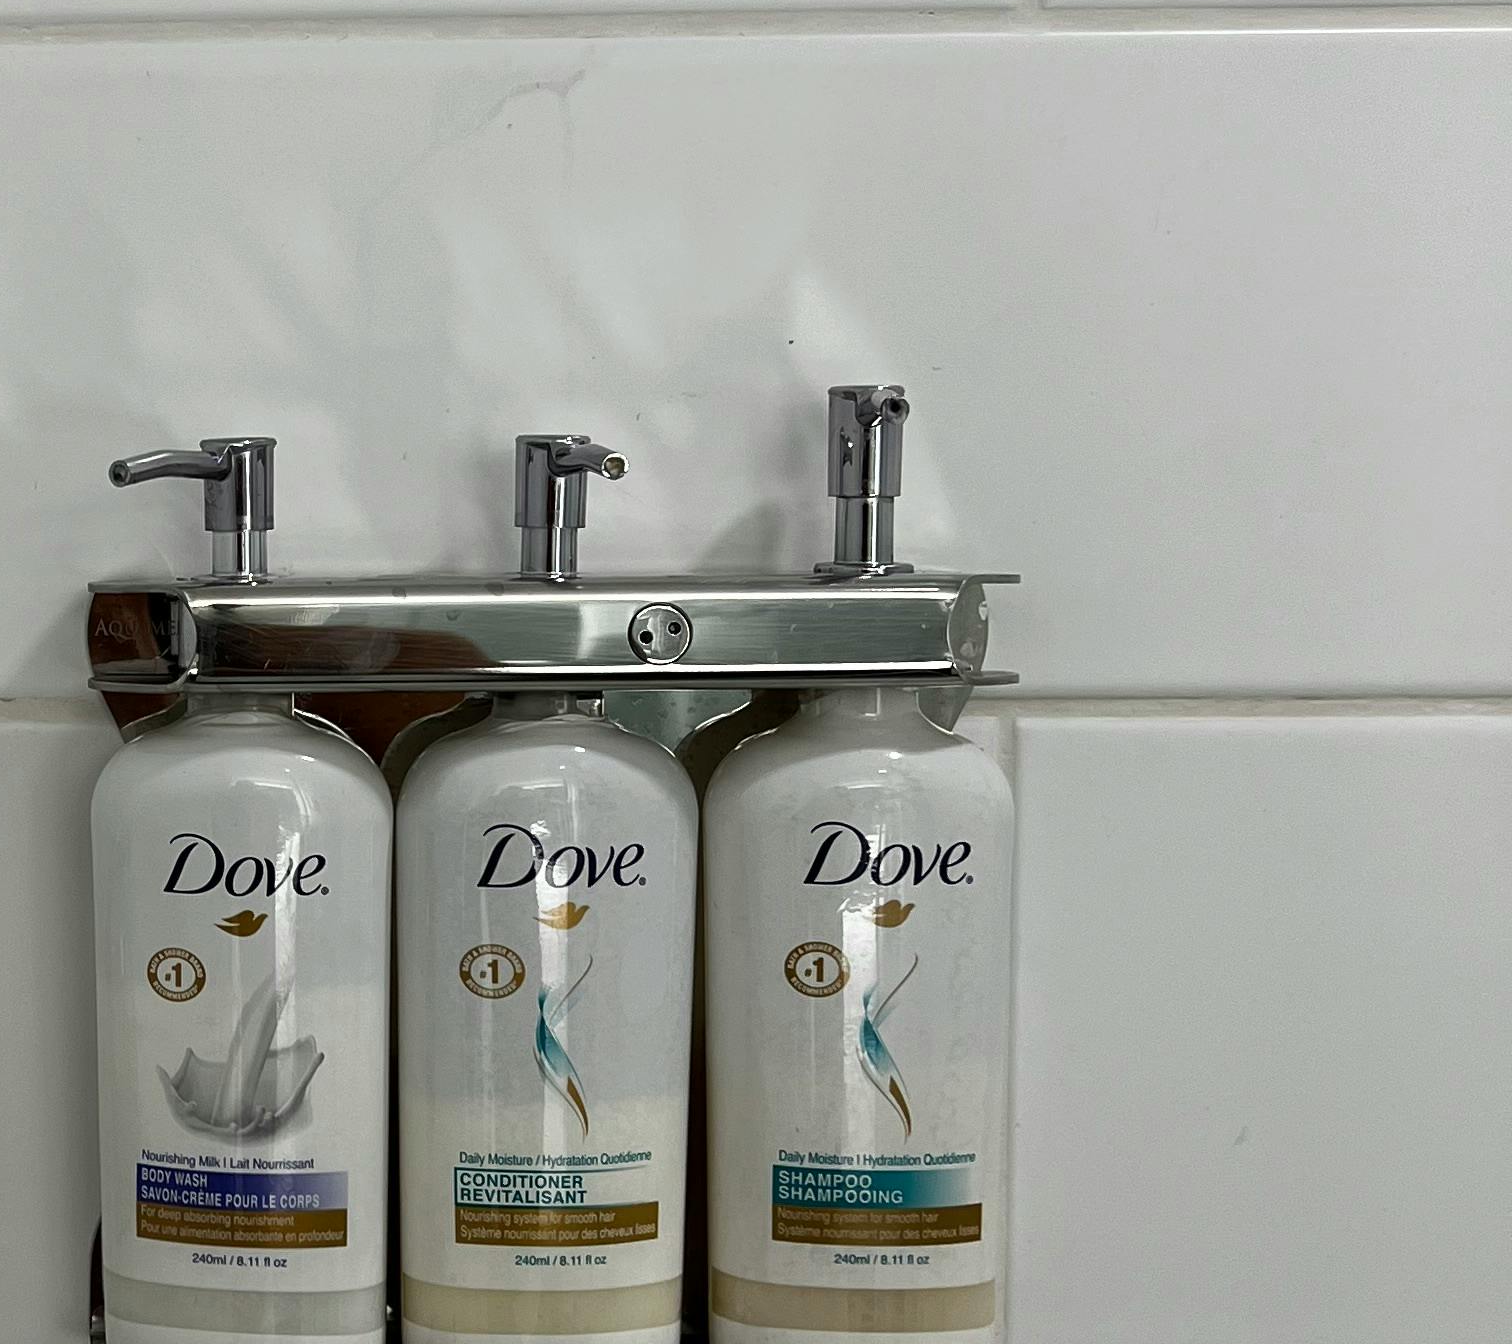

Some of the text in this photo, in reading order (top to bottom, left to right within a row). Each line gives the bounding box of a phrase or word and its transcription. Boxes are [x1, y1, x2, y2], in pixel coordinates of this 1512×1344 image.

[477, 824, 645, 888] Dove
[803, 821, 972, 886] Dove
[163, 833, 326, 897] Dove
[141, 1149, 196, 1168] Nourishing
[199, 1155, 220, 1168] Milk
[230, 1157, 250, 1169] Lait
[253, 1158, 314, 1170] Nourrissant
[459, 1151, 485, 1167] Daily
[488, 1153, 533, 1166] Moisture
[542, 1154, 598, 1169] Hydratation
[600, 1150, 652, 1165] Quotidienne
[778, 1150, 805, 1166] Daily
[808, 1152, 853, 1166] Moisture
[863, 1154, 921, 1169] Hydratation
[923, 1152, 976, 1165] Quotidienne
[141, 1167, 208, 1188] BODY WASH
[460, 1173, 583, 1189] CONDITIONER
[778, 1170, 872, 1188] SHAMPOO
[141, 1185, 320, 1208] SAVON-CRÈME POUR LE CORPS
[460, 1188, 587, 1204] REVITALISANT
[778, 1186, 904, 1204] SHAMPOOING
[141, 1204, 295, 1226] For deep absorbing nourishment
[460, 1209, 616, 1225] Nourishing system for smooth hair
[141, 1220, 344, 1245] Pour une alimentation absorbante en profondeur
[460, 1224, 502, 1240] Système
[504, 1229, 557, 1241] nourrissant
[559, 1230, 578, 1242] pour
[581, 1228, 598, 1240] des
[600, 1226, 633, 1239] cheveux
[879, 1230, 901, 1242] pour
[903, 1229, 920, 1239] des
[192, 1253, 227, 1265] 240ml
[237, 1256, 259, 1267] 8.11
[264, 1256, 271, 1267] fl
[273, 1258, 288, 1268] oz
[515, 1255, 550, 1266] 240ml
[559, 1255, 582, 1266] 8.11
[585, 1254, 592, 1265] fl
[594, 1255, 607, 1265] oz
[834, 1254, 870, 1265] 240ml
[880, 1254, 903, 1265] 8.11
[907, 1254, 914, 1265] fl
[916, 1255, 930, 1265] oz
